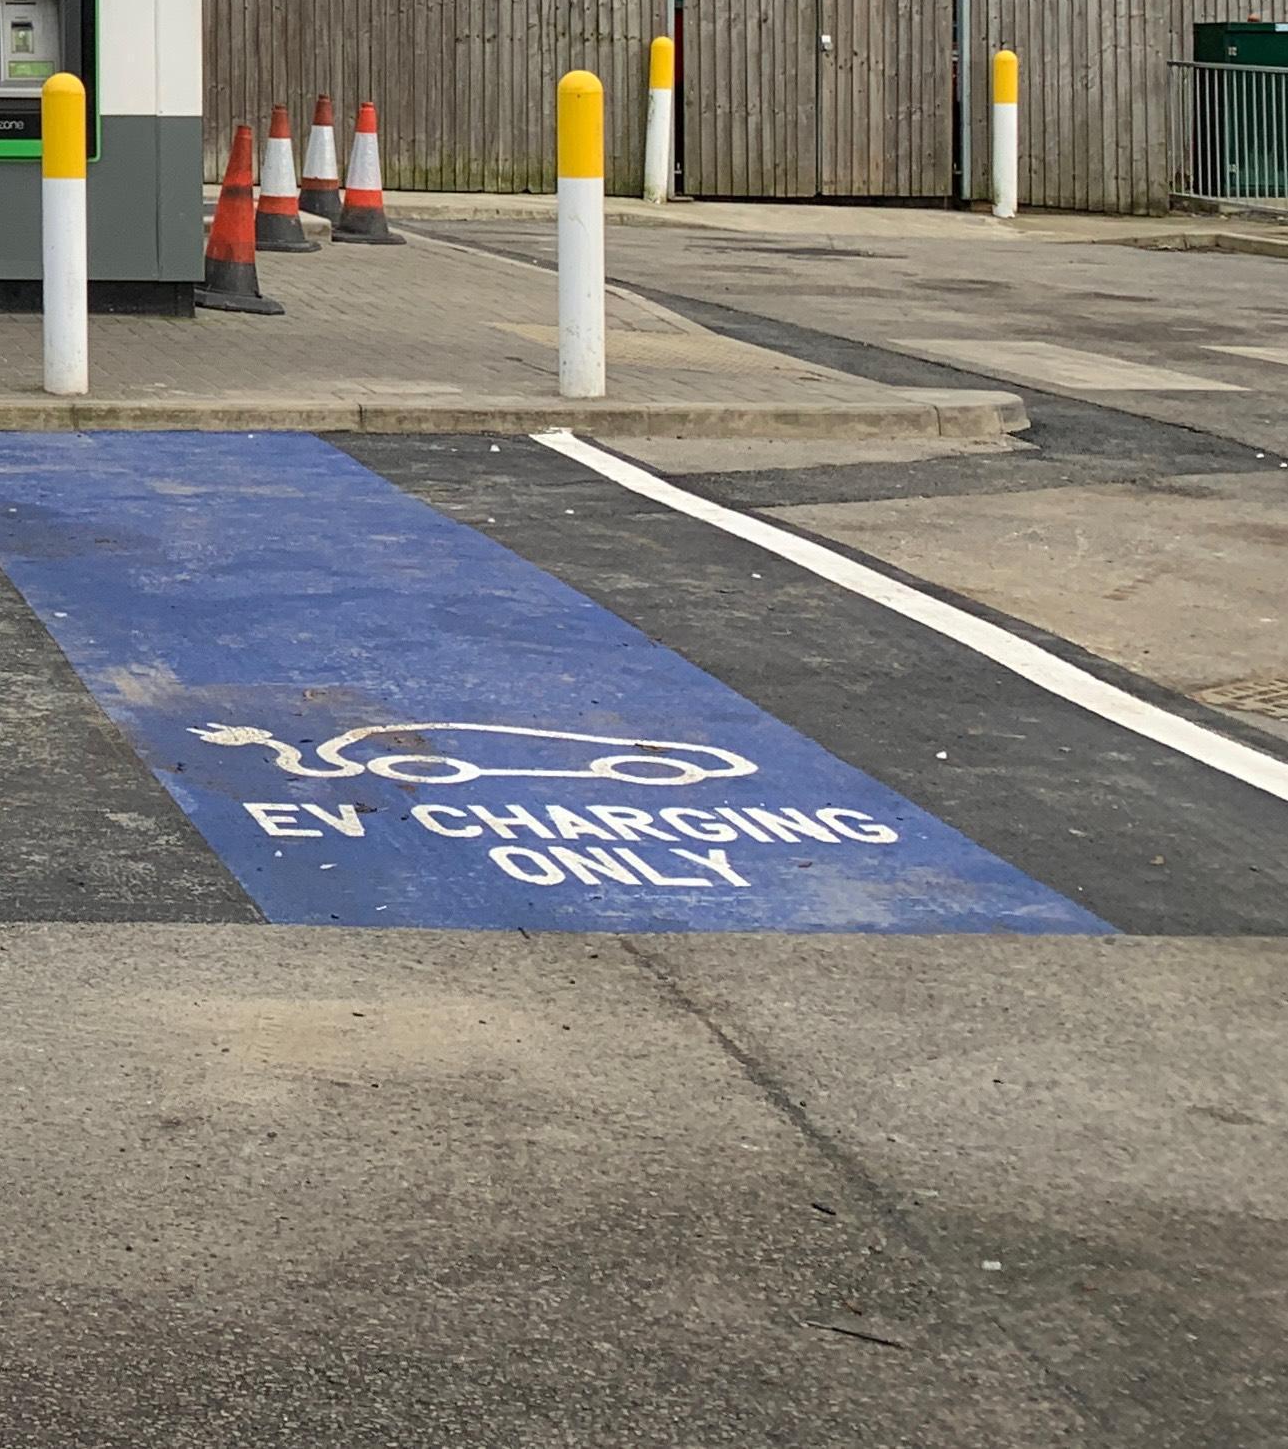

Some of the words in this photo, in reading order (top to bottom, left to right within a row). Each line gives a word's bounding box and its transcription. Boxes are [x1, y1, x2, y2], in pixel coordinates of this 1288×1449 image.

[243, 802, 365, 838] EV
[410, 803, 899, 844] CHARGING
[488, 845, 751, 888] ONLY
